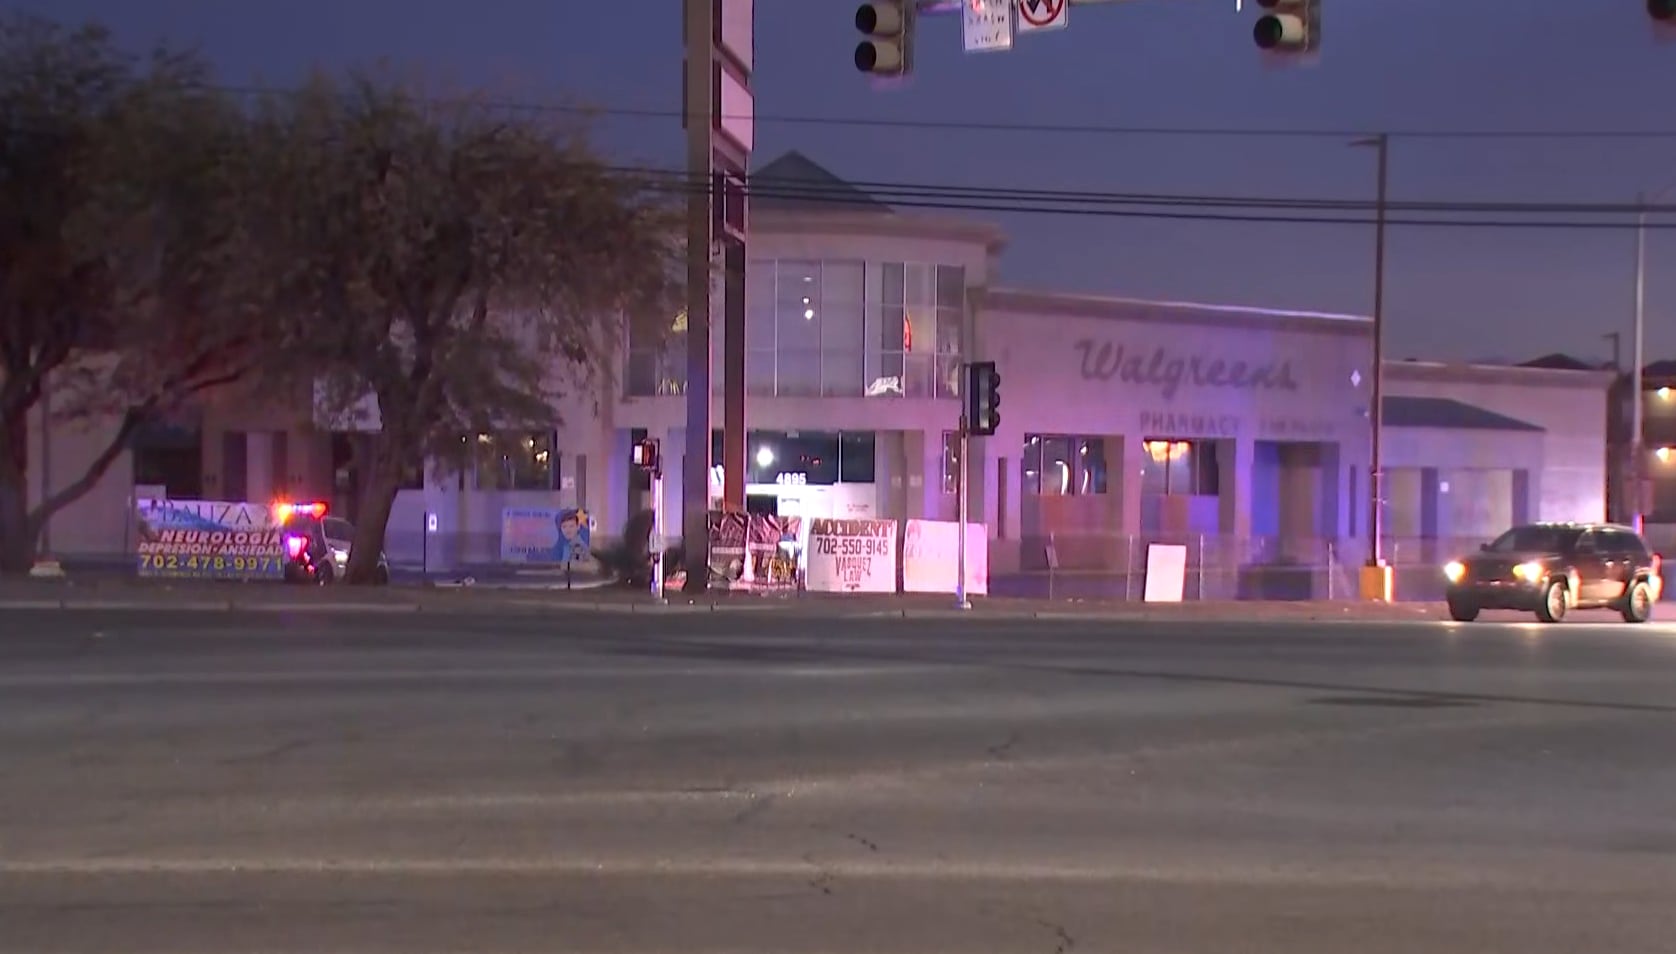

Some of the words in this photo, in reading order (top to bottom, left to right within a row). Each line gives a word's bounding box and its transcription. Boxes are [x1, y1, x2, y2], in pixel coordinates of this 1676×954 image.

[1074, 339, 1297, 399] Walgreens
[1139, 410, 1240, 436] PHARMACY
[776, 472, 806, 485] 4895
[816, 536, 888, 556] 702-550-9145
[843, 570, 862, 582] LAW
